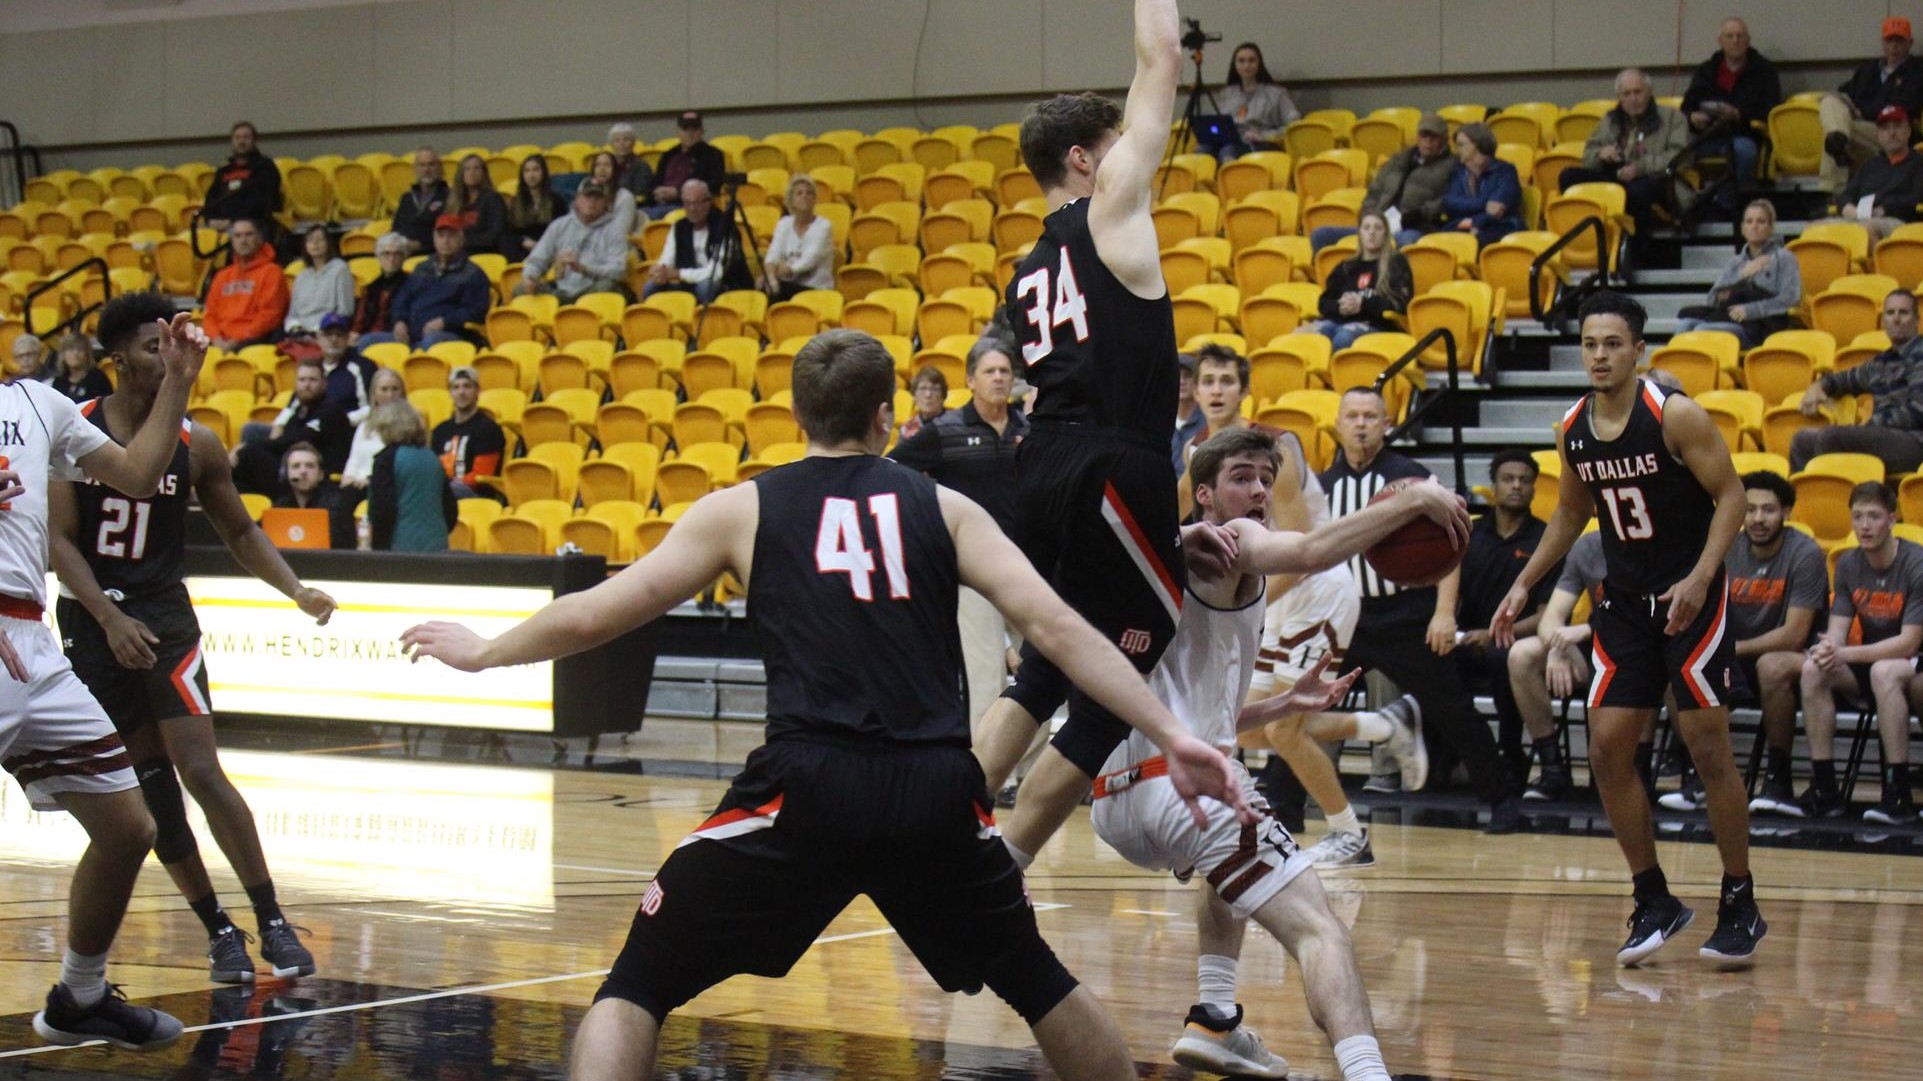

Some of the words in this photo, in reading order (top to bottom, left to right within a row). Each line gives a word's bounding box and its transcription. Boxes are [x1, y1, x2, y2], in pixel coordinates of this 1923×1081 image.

[1016, 244, 1090, 367] 34
[0, 419, 26, 446] IX
[1576, 461, 1595, 483] UT
[1596, 452, 1659, 481] DALLAS
[96, 496, 152, 560] 21
[1601, 486, 1654, 541] 13
[814, 491, 911, 602] 41
